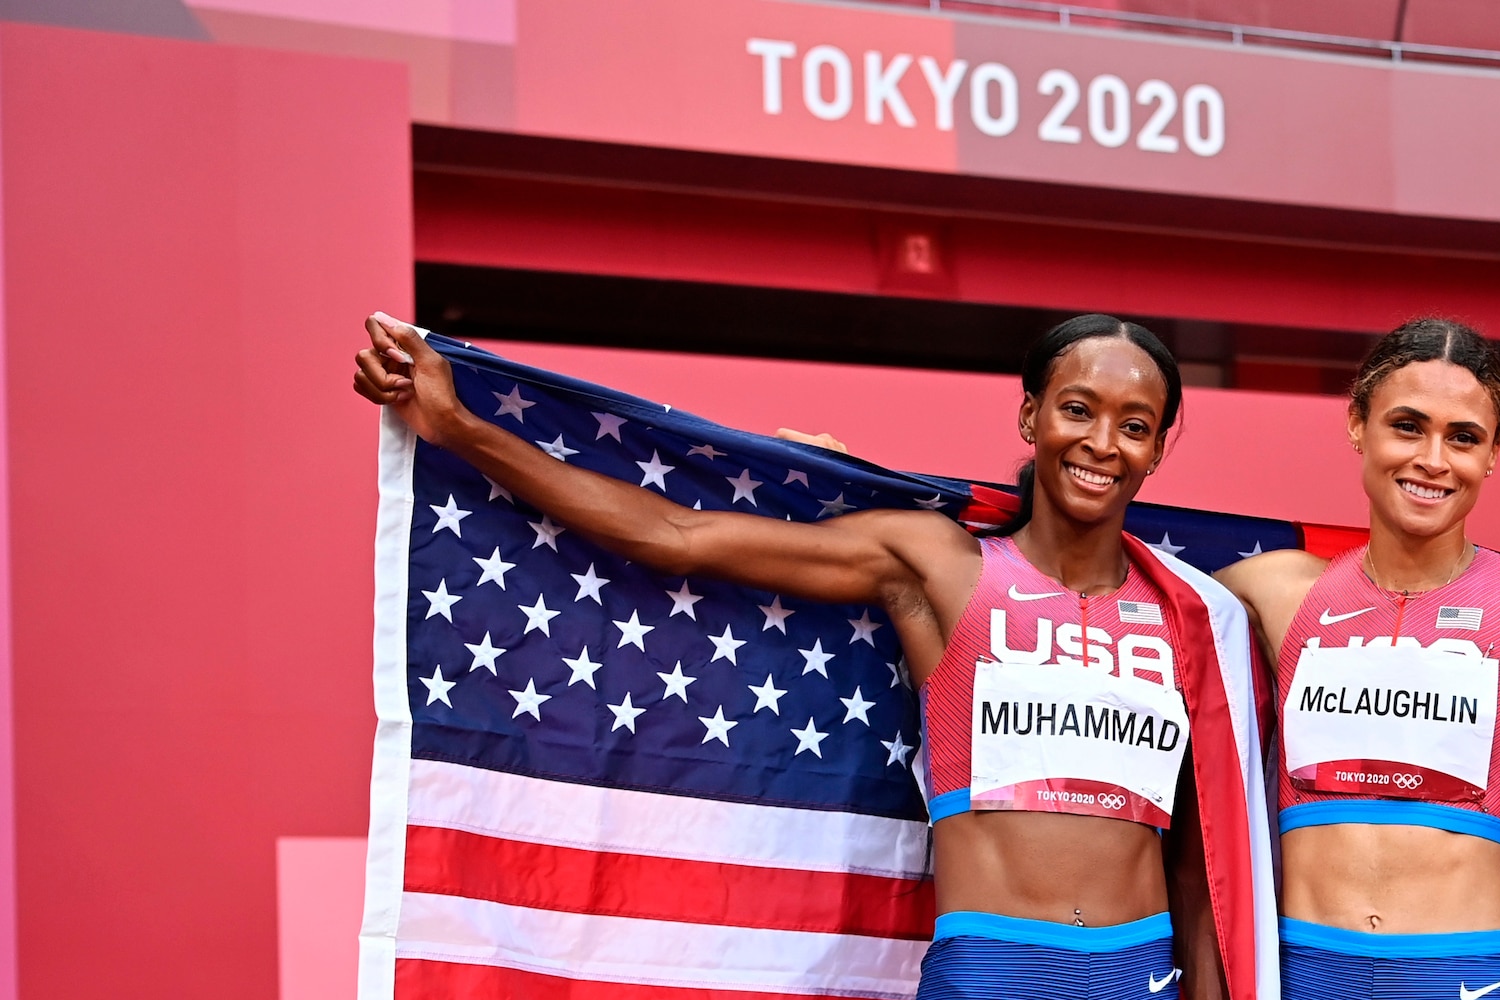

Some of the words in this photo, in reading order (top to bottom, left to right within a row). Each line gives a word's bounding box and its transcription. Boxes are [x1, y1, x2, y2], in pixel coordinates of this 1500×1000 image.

[747, 38, 1020, 138] TOKYO
[1037, 69, 1226, 158] 2020
[990, 607, 1176, 686] USA
[981, 700, 1181, 752] MUHAMMAD
[1299, 685, 1478, 725] McLAUGHLIN
[1036, 790, 1070, 801] TOKYO
[1070, 792, 1095, 804] 2020
[1335, 770, 1366, 783] TOKYO
[1366, 773, 1390, 785] 2020
